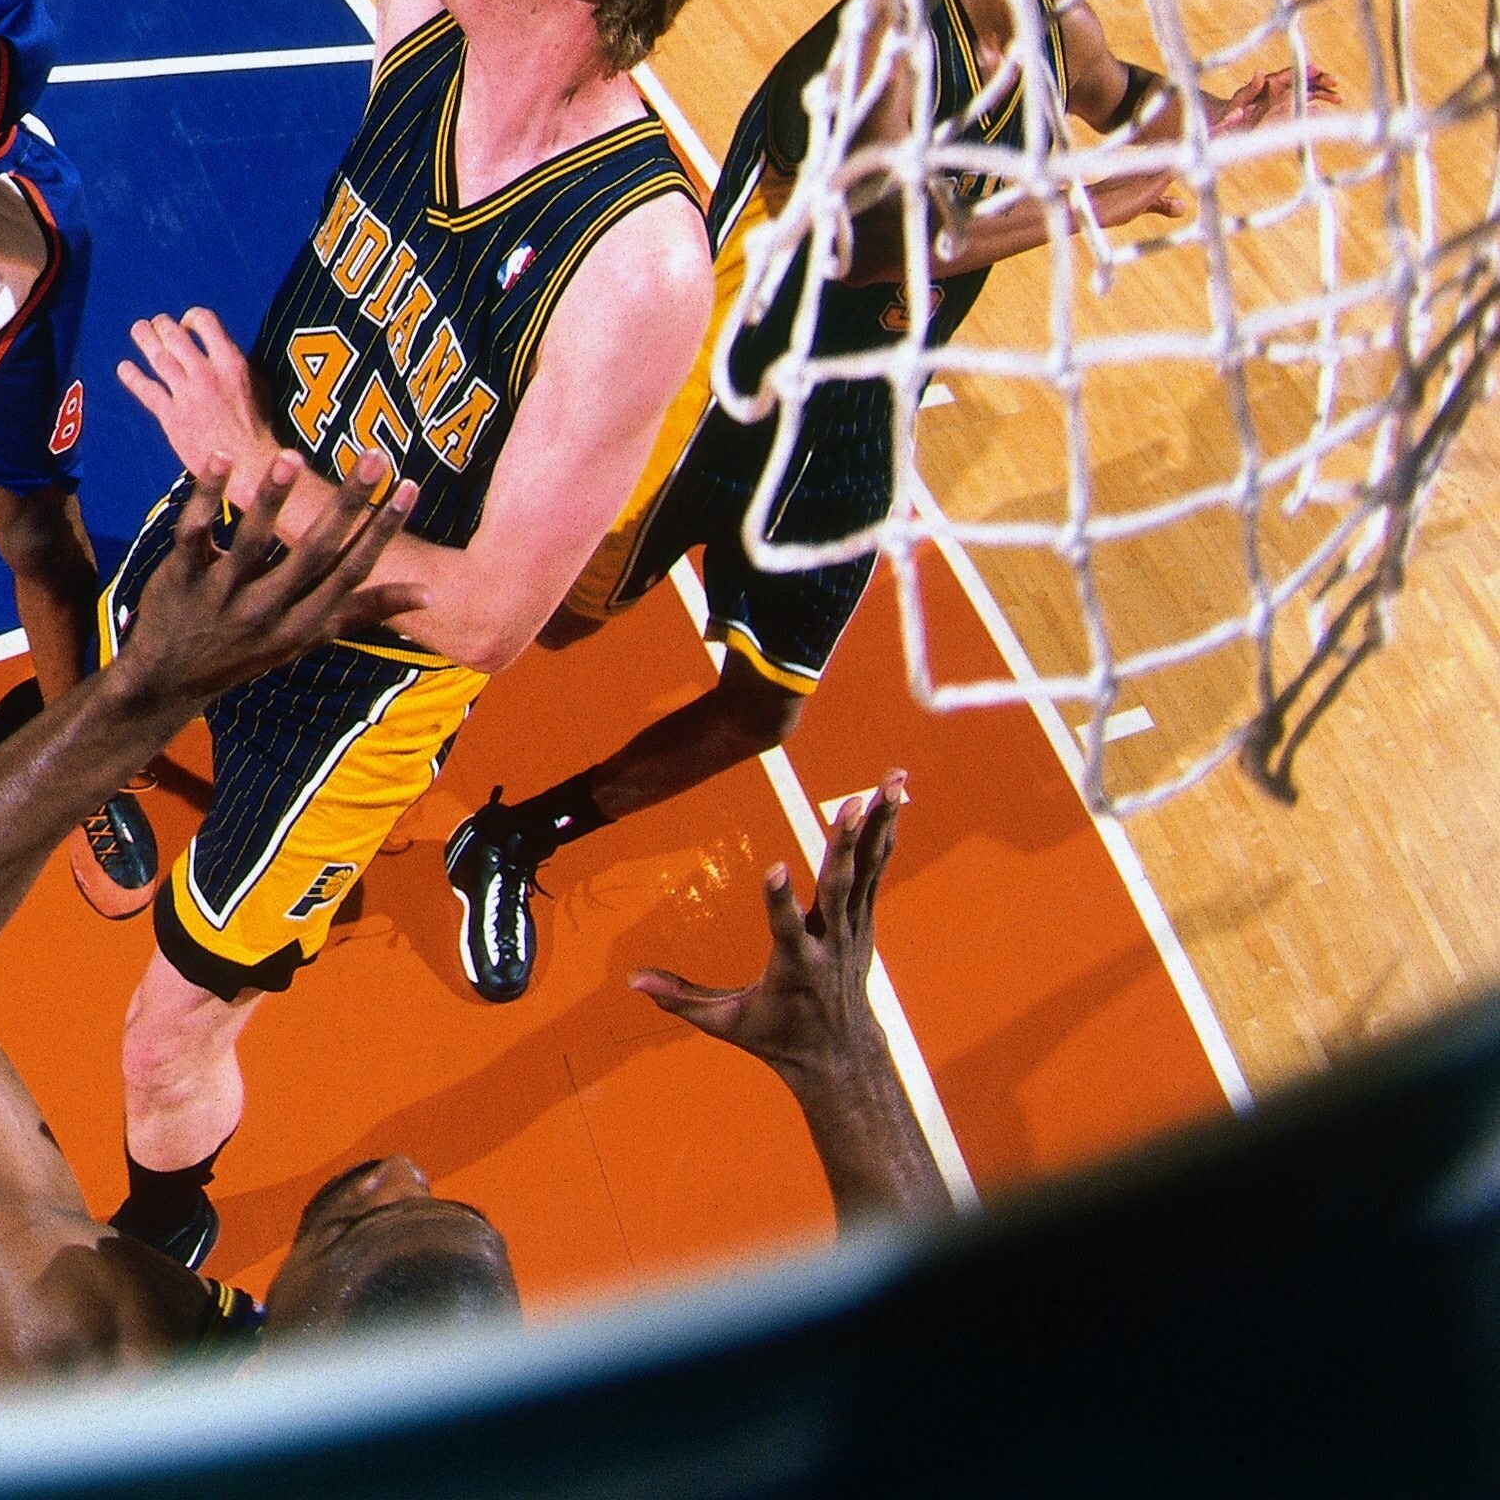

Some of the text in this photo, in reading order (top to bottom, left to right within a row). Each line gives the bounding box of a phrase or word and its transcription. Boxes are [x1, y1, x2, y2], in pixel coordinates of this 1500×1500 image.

[286, 325, 413, 506] 45
[313, 177, 499, 474] NDIANA
[47, 379, 84, 455] 8
